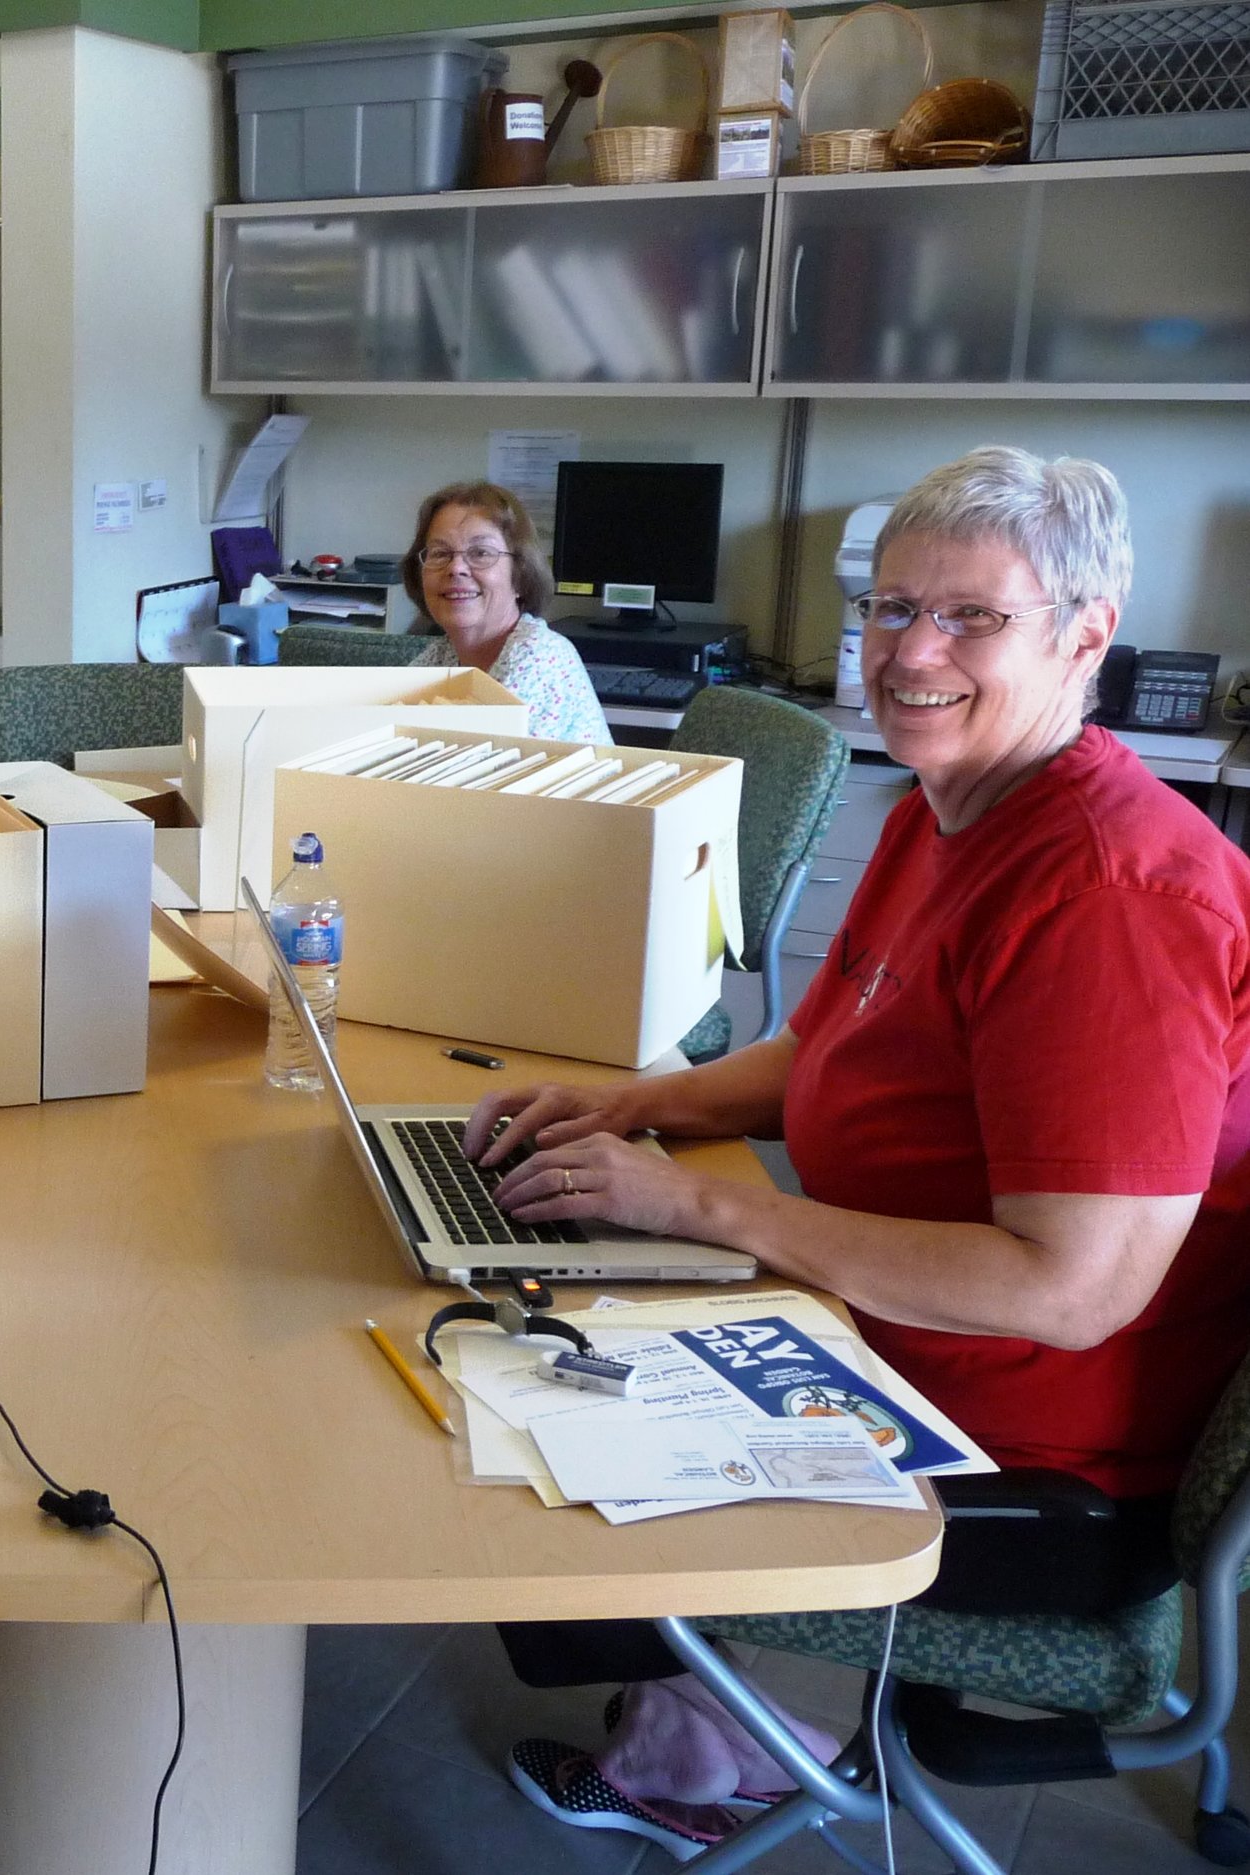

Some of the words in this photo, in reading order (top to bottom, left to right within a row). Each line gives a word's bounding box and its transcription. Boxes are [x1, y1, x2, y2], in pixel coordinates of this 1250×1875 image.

[295, 942, 332, 953] SPRING
[640, 1344, 671, 1354] Edible
[660, 1365, 697, 1377] Annual
[757, 1379, 789, 1390] OBISPO
[691, 1385, 726, 1399] Spring
[643, 1391, 690, 1406] Planting
